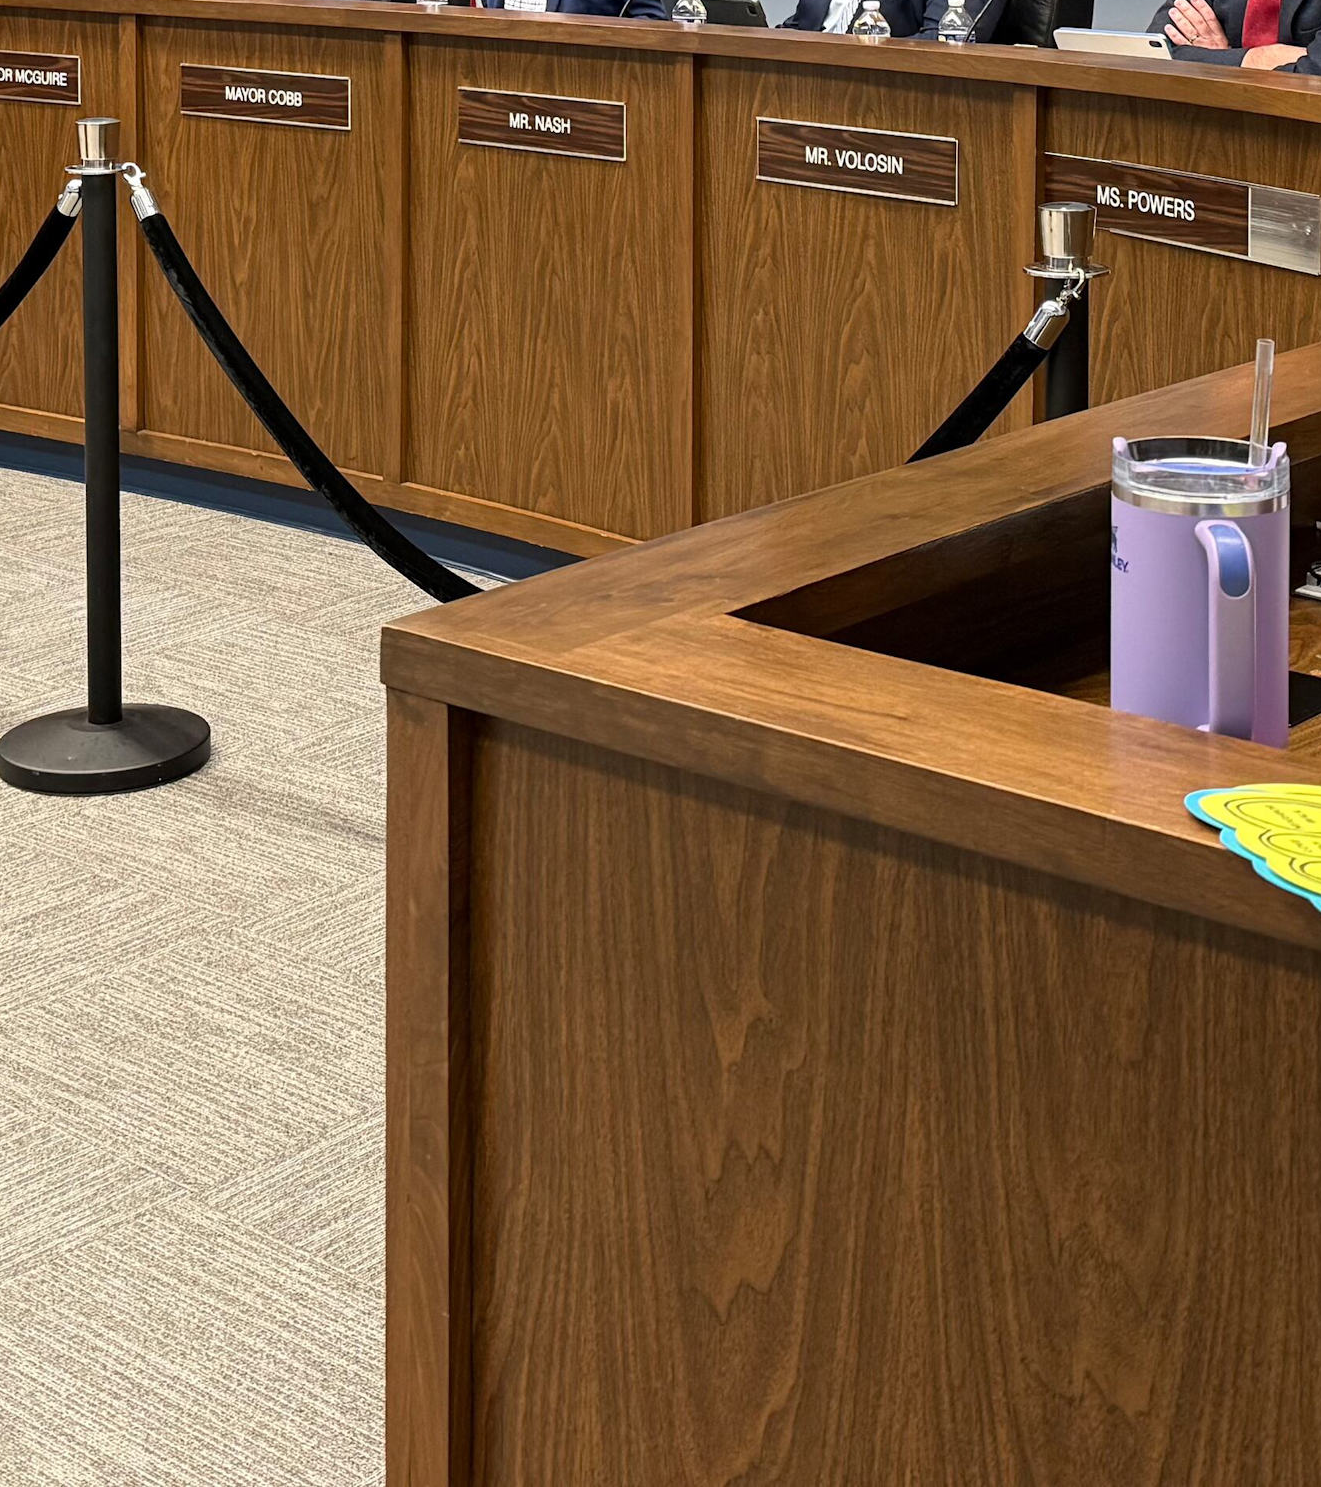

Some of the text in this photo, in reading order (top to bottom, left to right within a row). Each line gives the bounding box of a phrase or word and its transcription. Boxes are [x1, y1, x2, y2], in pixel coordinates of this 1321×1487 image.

[15, 68, 68, 87] MCGUIRE
[225, 85, 303, 107] MAYOR COBB
[509, 112, 571, 134] MR. NASH
[805, 145, 903, 175] MR. VOLOSIN
[1096, 184, 1195, 221] MS. POWERS
